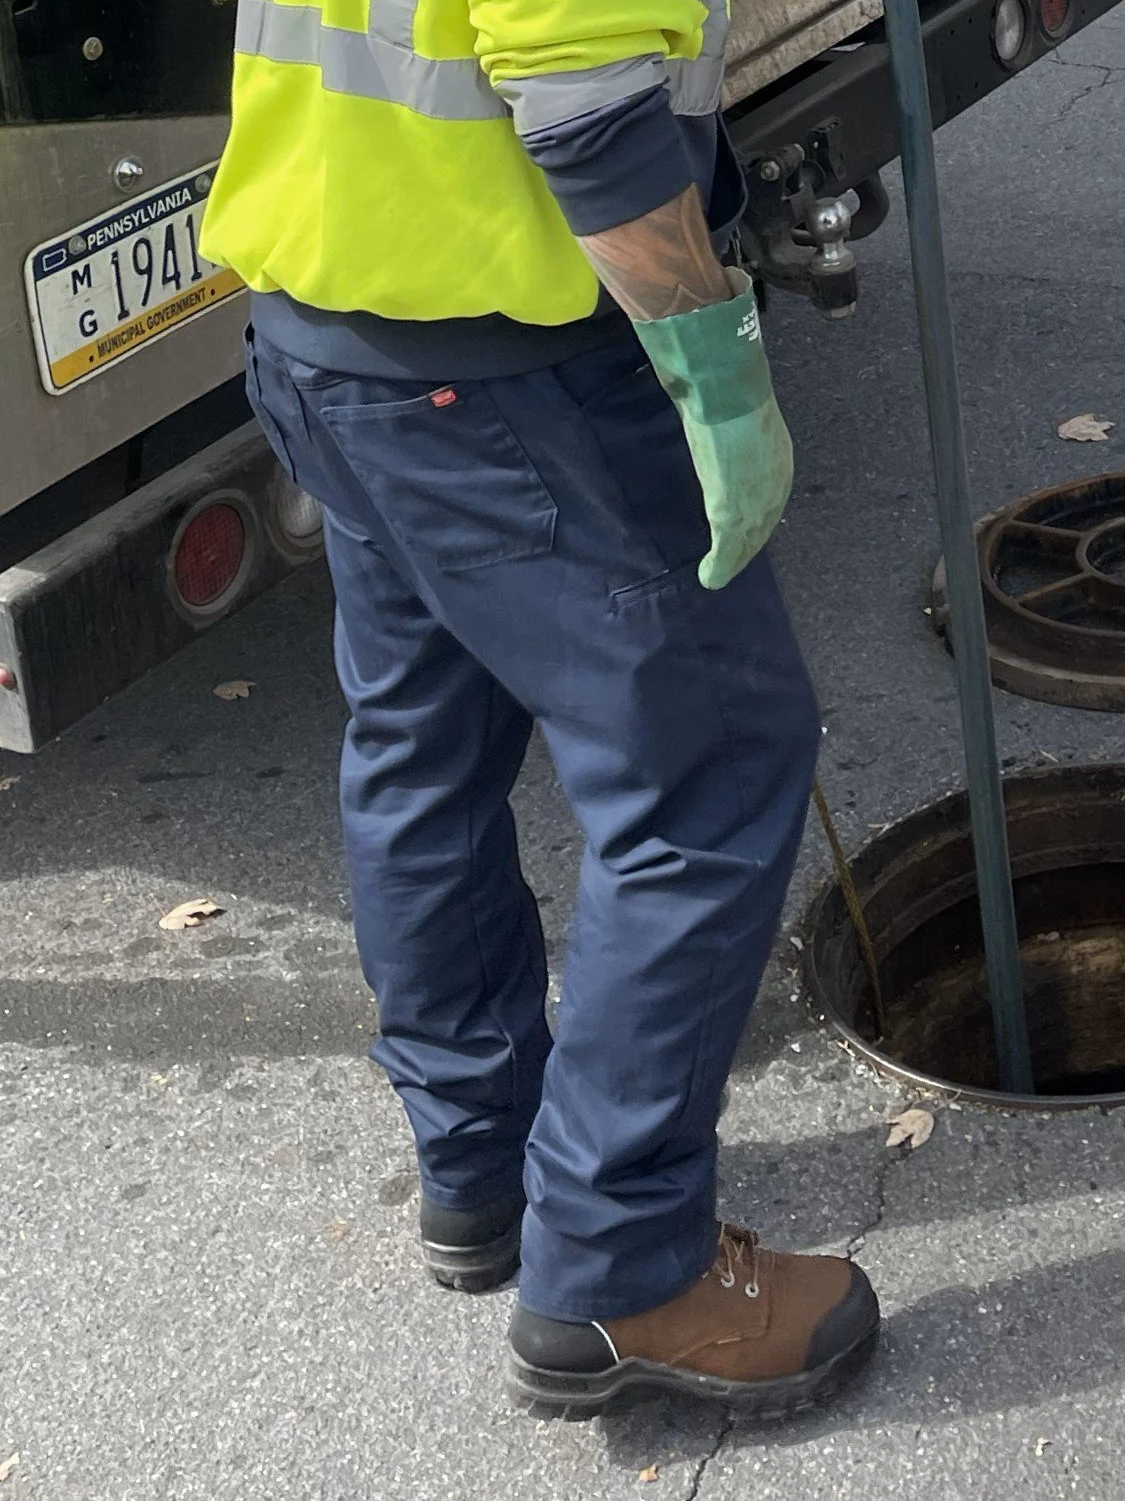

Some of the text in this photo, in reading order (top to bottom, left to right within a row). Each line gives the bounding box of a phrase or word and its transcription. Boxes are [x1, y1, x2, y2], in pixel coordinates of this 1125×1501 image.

[87, 187, 192, 250] PENNSYLVANIA
[71, 263, 92, 295] M
[111, 213, 217, 321] 1941
[79, 309, 98, 338] G
[96, 286, 206, 358] MUNICIPAL GOVERNMENT
